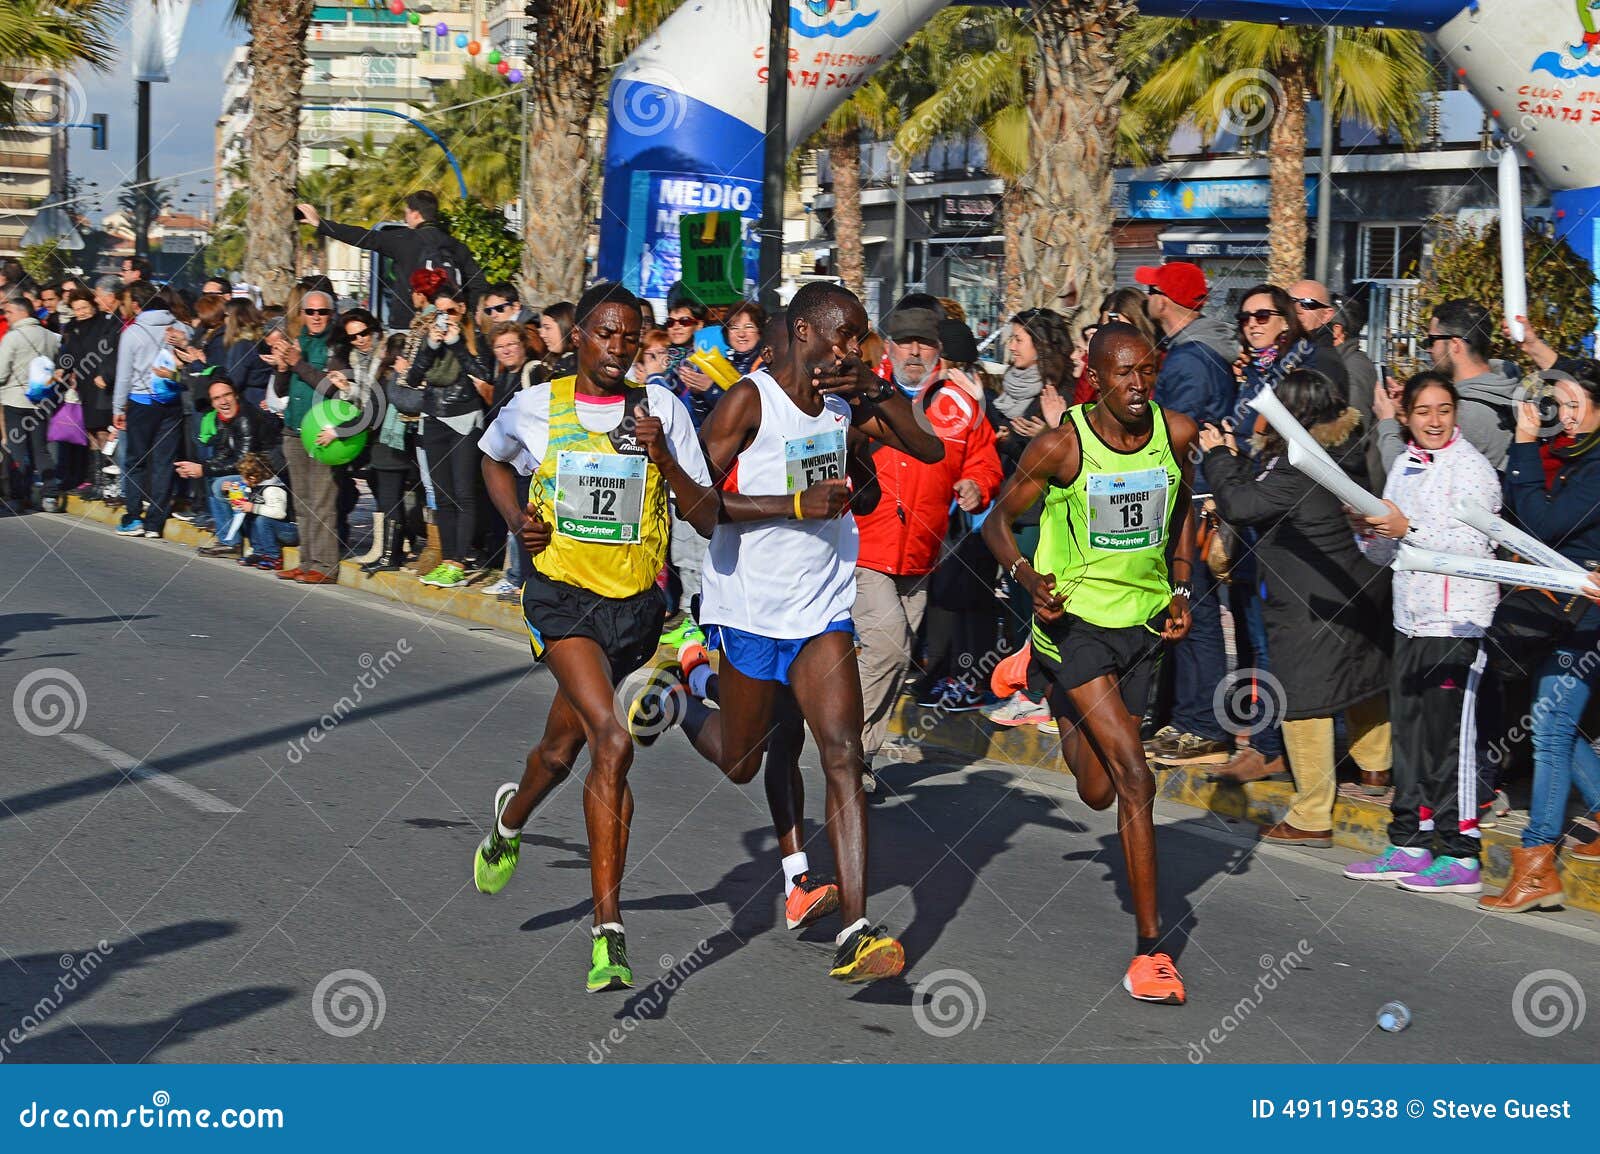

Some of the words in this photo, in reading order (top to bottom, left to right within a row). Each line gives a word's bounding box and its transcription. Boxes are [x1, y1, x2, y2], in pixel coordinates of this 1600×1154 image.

[753, 46, 799, 62] CB
[757, 67, 820, 88] SNTA
[1518, 85, 1563, 100] CLUB
[1517, 101, 1583, 122] SANTA
[659, 179, 753, 211] MEDIO
[579, 475, 626, 489] KIPKORIR
[589, 489, 617, 516] 12
[1110, 491, 1149, 505] KIPKOGEI
[1119, 503, 1144, 528] 13
[576, 524, 616, 534] Sprinter
[1110, 536, 1146, 546] Sprinter
